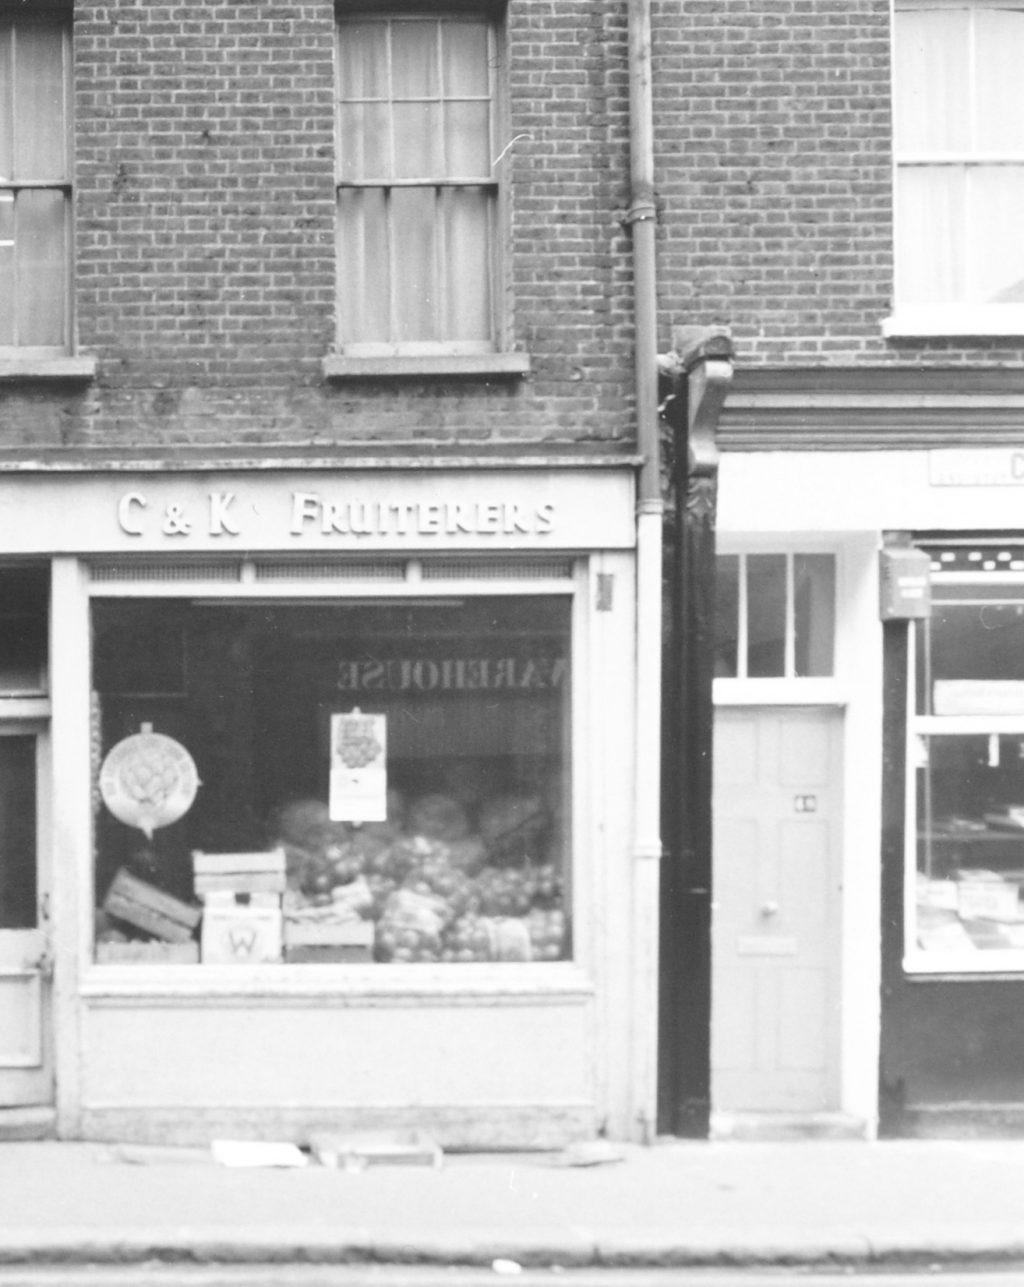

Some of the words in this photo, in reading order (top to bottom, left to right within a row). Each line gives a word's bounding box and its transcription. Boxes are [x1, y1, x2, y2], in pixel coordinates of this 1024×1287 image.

[117, 491, 148, 537] C
[162, 501, 192, 537] &
[208, 491, 240, 537] K
[289, 491, 556, 537] FRUITERERS
